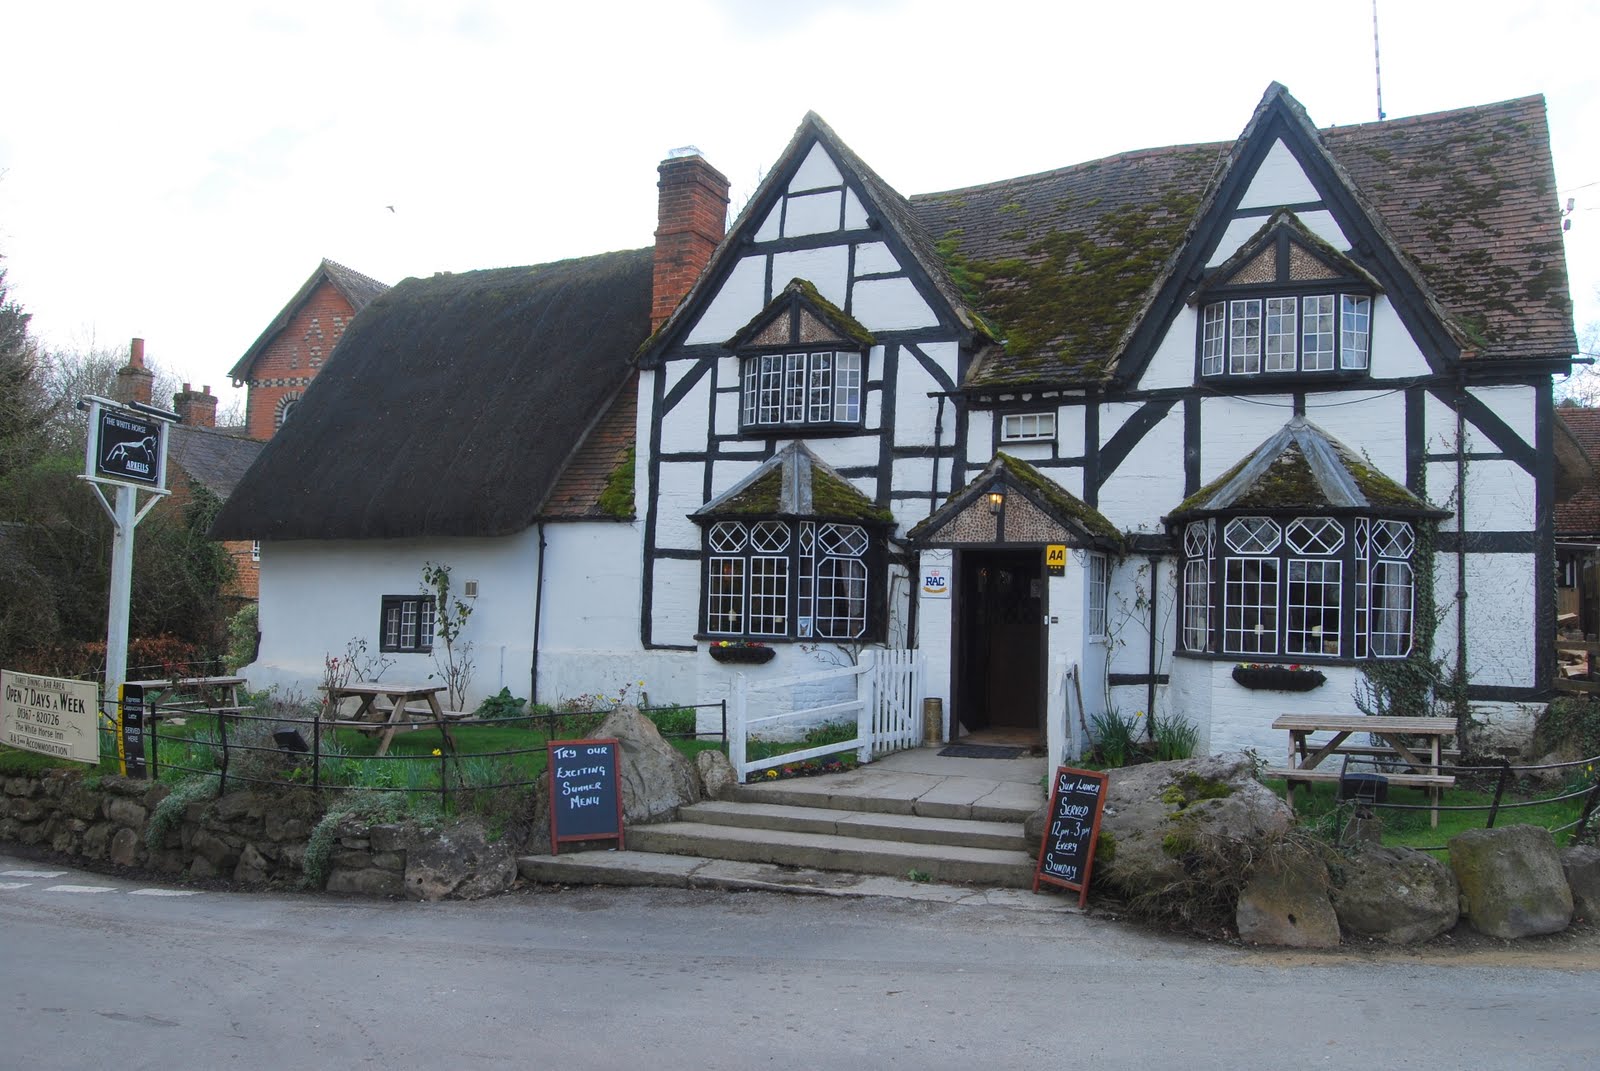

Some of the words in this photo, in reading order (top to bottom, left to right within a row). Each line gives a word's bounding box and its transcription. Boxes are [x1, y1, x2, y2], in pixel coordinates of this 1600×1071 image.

[106, 417, 115, 427] THE
[116, 419, 131, 430] WHITE
[131, 423, 146, 434] HORSE
[1049, 550, 1063, 560] AA
[925, 577, 945, 586] RAC
[6, 685, 22, 704] OPEN
[24, 688, 29, 705] 7
[31, 688, 51, 709] DAYS
[60, 693, 85, 714] WEEK
[36, 711, 60, 726] 820726
[16, 722, 24, 732] The
[24, 724, 37, 735] White
[38, 727, 54, 738] Horse
[55, 730, 64, 740] Inn
[125, 726, 140, 734] SERVED
[26, 738, 68, 756] ACCOMMODATION
[554, 747, 577, 759] TRY
[587, 747, 608, 755] OUR
[556, 766, 606, 778] EXCITING
[562, 781, 602, 796] SUMMER
[1058, 774, 1074, 792] SUN
[1076, 778, 1100, 793] LUNCH
[570, 796, 600, 809] MENU
[1060, 796, 1088, 818] SERVED
[1056, 842, 1078, 852] EVERY
[1046, 853, 1077, 878] SUNDAY
